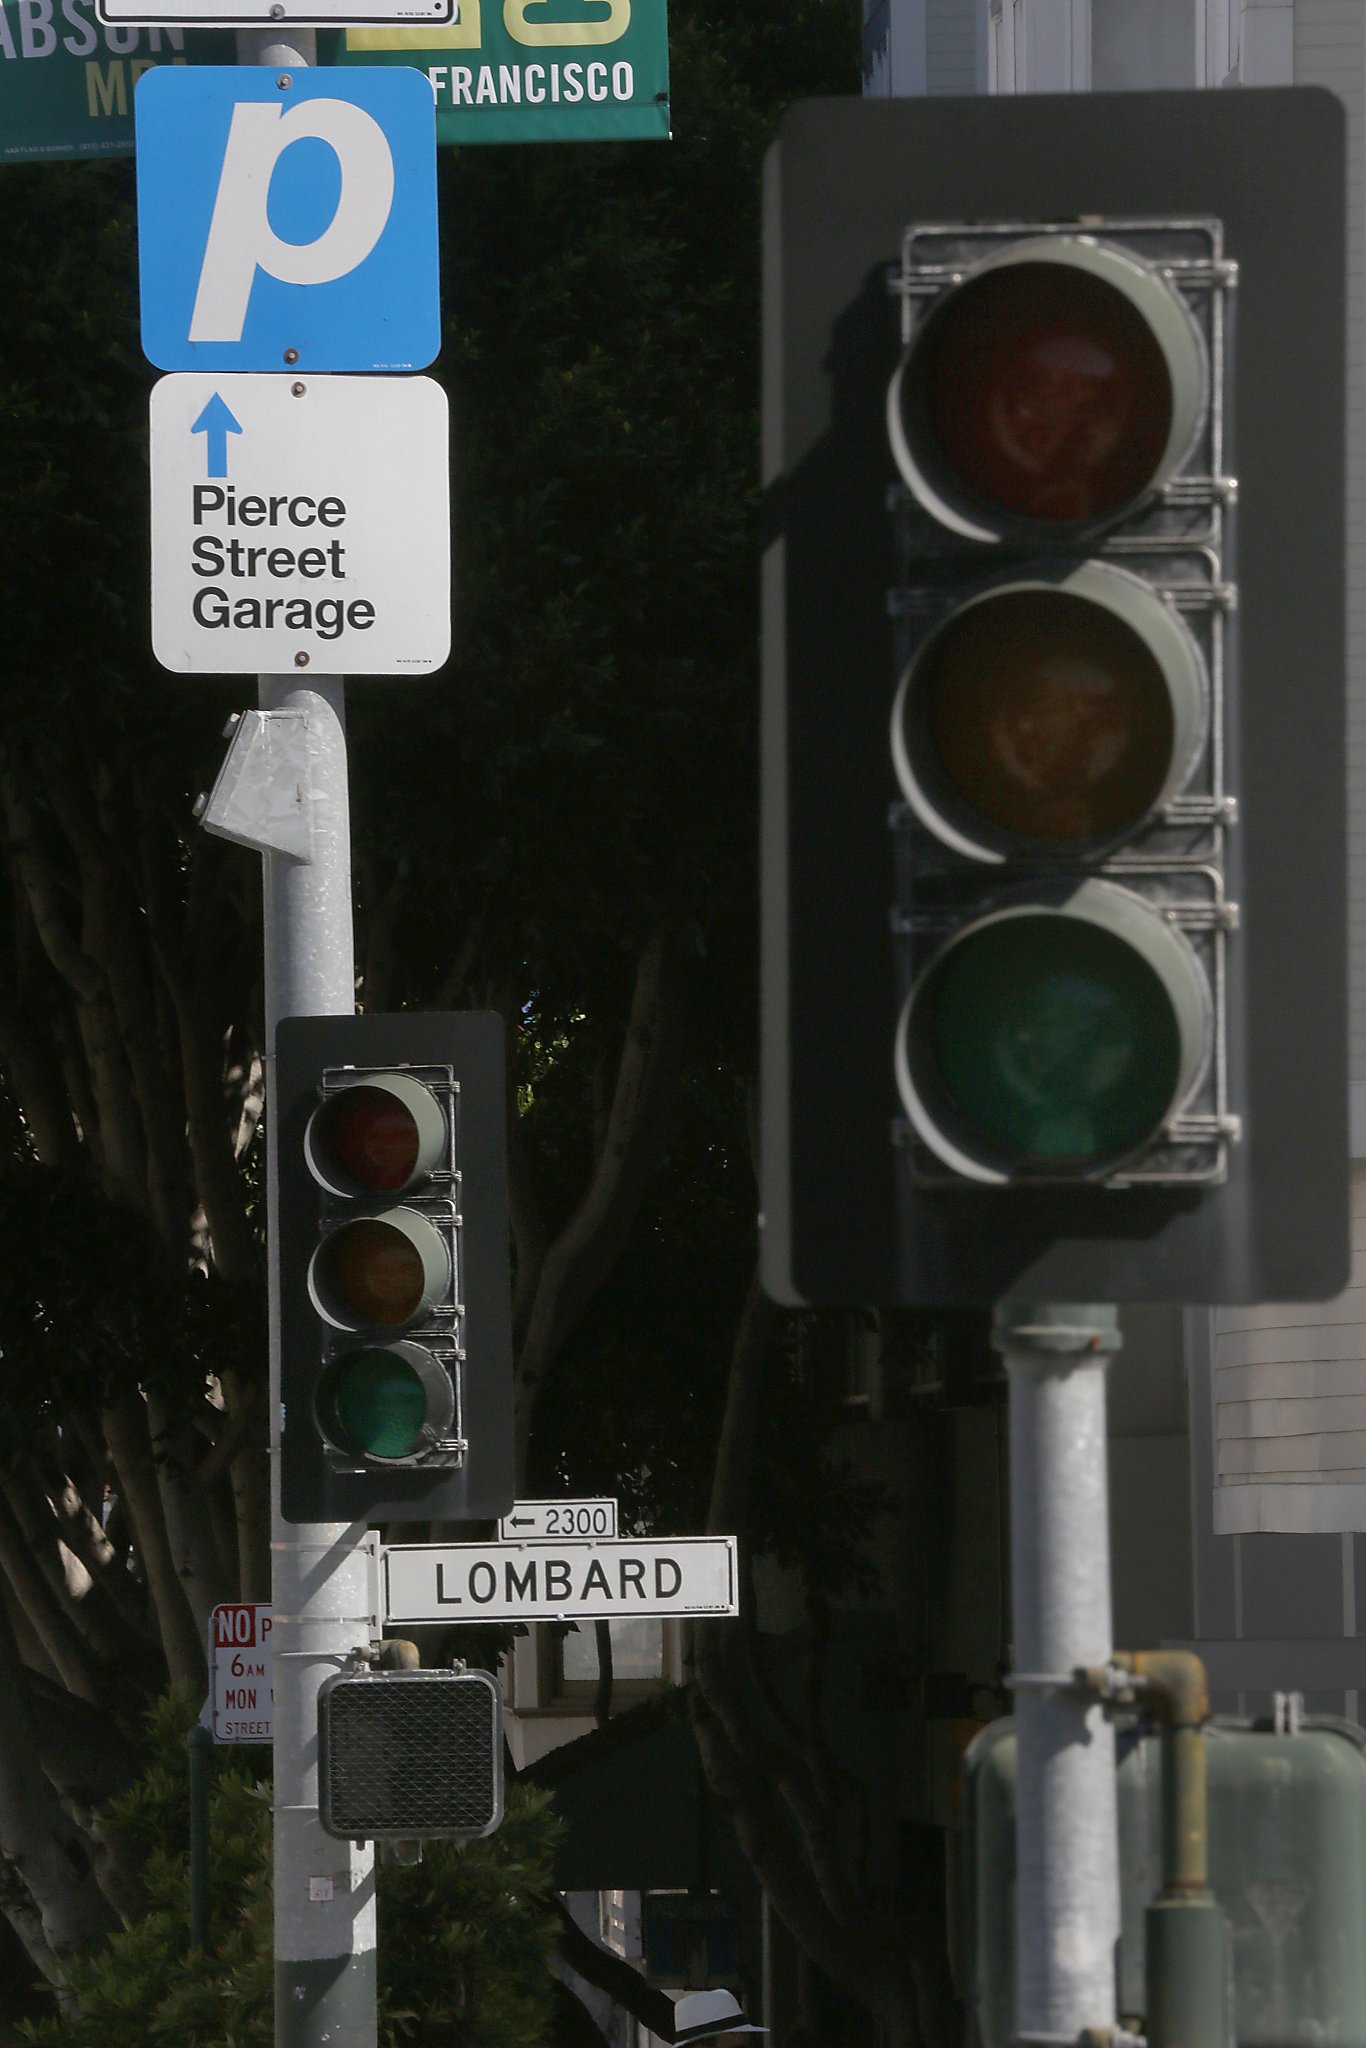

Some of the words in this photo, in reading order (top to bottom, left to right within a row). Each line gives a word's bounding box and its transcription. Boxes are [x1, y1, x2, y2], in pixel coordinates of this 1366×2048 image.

[428, 61, 634, 105] FRANCISCO
[192, 485, 346, 527] Pierce
[191, 535, 346, 578] Street
[192, 586, 376, 640] Garage
[545, 1508, 607, 1535] 2300
[435, 1557, 683, 1605] LOMBARD
[218, 1609, 251, 1643] NO
[225, 1688, 257, 1710] MON
[225, 1721, 271, 1735] STREET
